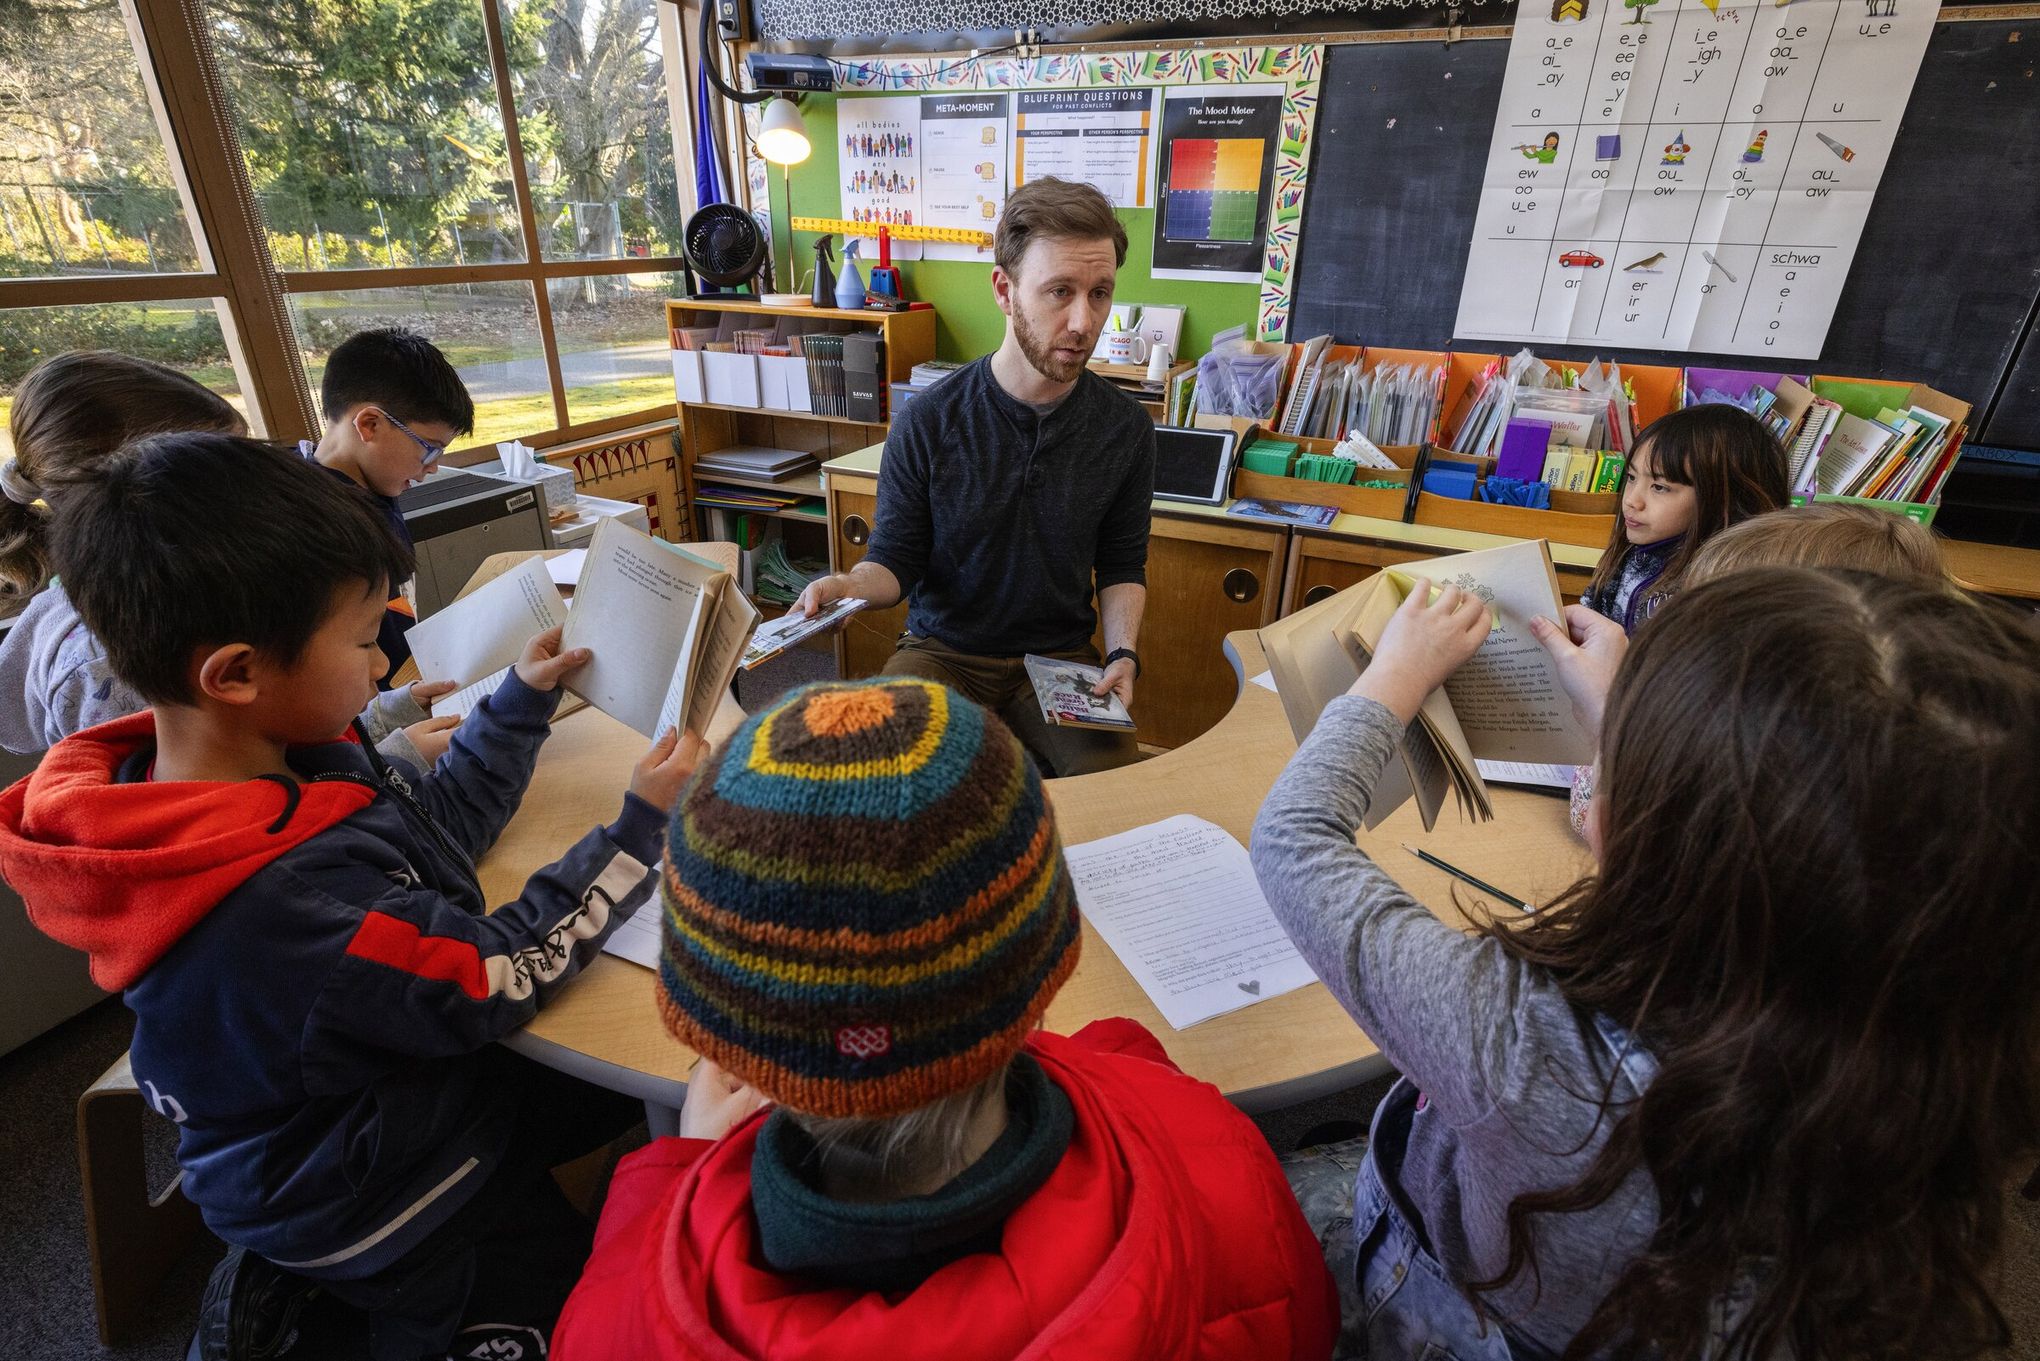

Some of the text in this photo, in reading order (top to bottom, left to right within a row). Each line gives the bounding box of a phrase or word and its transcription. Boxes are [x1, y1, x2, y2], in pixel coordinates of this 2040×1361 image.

[1616, 53, 1634, 63] ee
[1611, 71, 1630, 81] ea
[1764, 67, 1788, 77] ow
[1024, 91, 1143, 103] BLUEPRINT QUESTIONS
[935, 103, 995, 113] META-MOMENT
[1188, 106, 1255, 115] The Mood Meter
[1603, 107, 1612, 116] e
[1675, 103, 1679, 115] i
[1753, 105, 1763, 114] o
[1833, 103, 1844, 113] u
[1532, 109, 1540, 118] a
[856, 121, 900, 129] all bodies
[1519, 170, 1538, 178] ew
[1592, 170, 1610, 179] oo
[1515, 186, 1532, 194] oo
[1654, 187, 1675, 195] ow
[1806, 188, 1831, 197] aw
[871, 198, 890, 206] good
[1507, 226, 1515, 234] u
[1772, 251, 1820, 264] schwa
[1785, 272, 1796, 280] a
[1565, 280, 1581, 288] ar
[1632, 282, 1648, 291] er
[1701, 285, 1717, 293] or
[1780, 288, 1790, 297] e
[1629, 295, 1639, 306] ir
[1778, 302, 1783, 313] i
[1625, 314, 1639, 322] ur
[1770, 321, 1779, 329] o
[1765, 337, 1774, 345] u
[1966, 446, 2018, 460] INBOX
[1498, 637, 1518, 645] News
